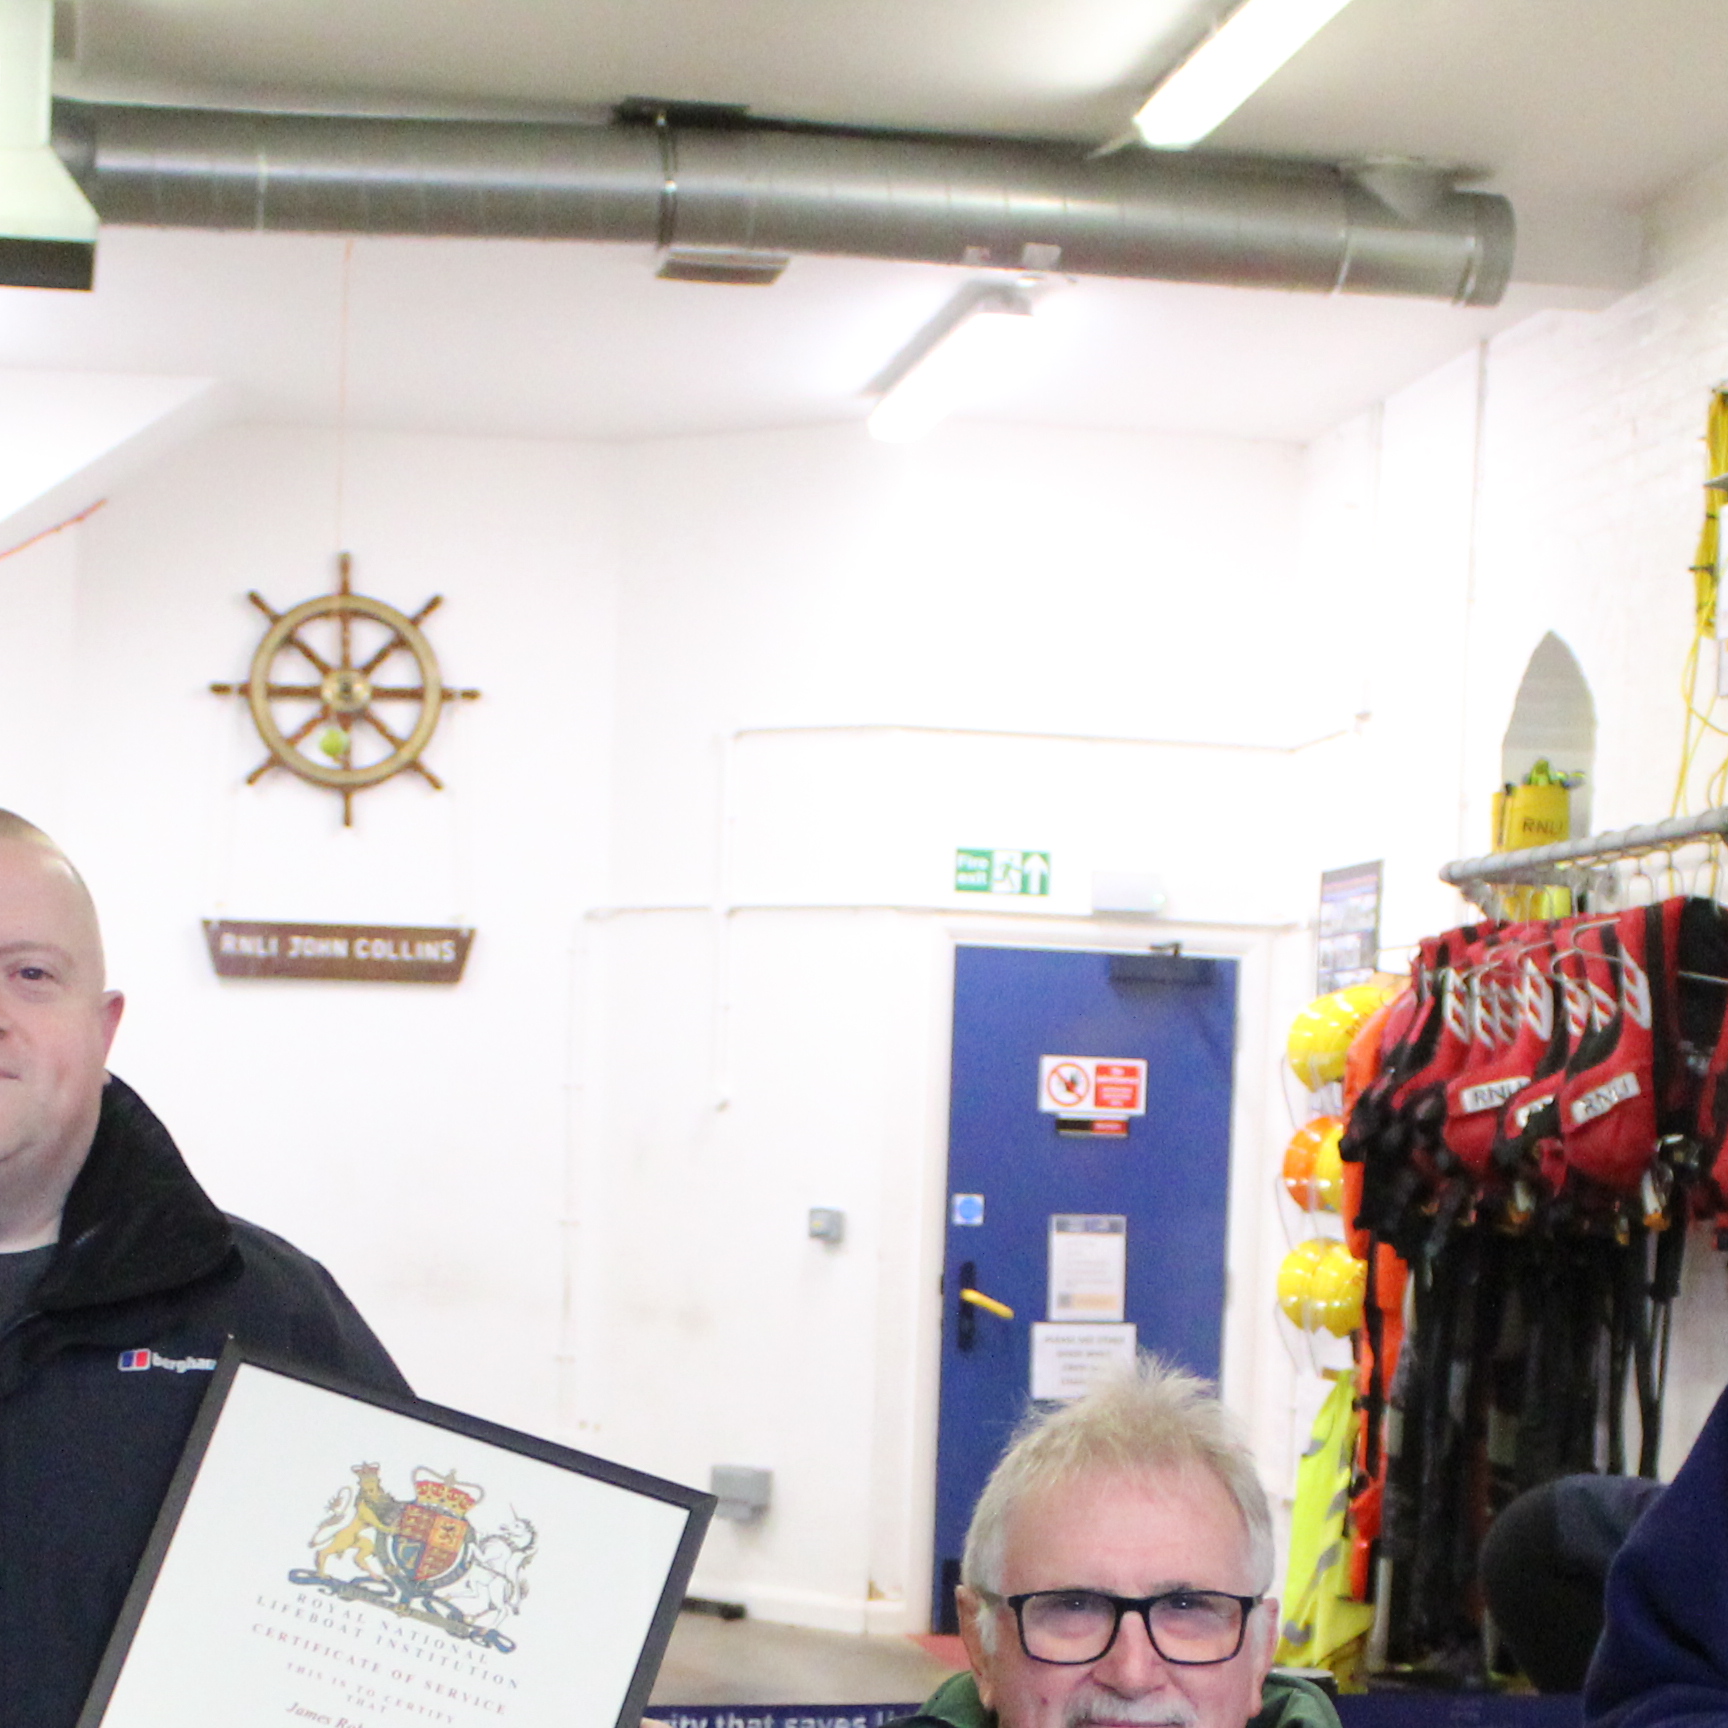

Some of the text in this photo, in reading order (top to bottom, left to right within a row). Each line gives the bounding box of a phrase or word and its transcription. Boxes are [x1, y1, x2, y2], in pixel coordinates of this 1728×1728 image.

[221, 933, 456, 962] RNLI JOHN COLLINS
[256, 1596, 519, 1689] LIFEBOAT INSTITUTION
[296, 1594, 489, 1663] ROYAL NATIONAL
[251, 1623, 506, 1714] CERTIFICATE OF SERVICE
[285, 1700, 332, 1725] James
